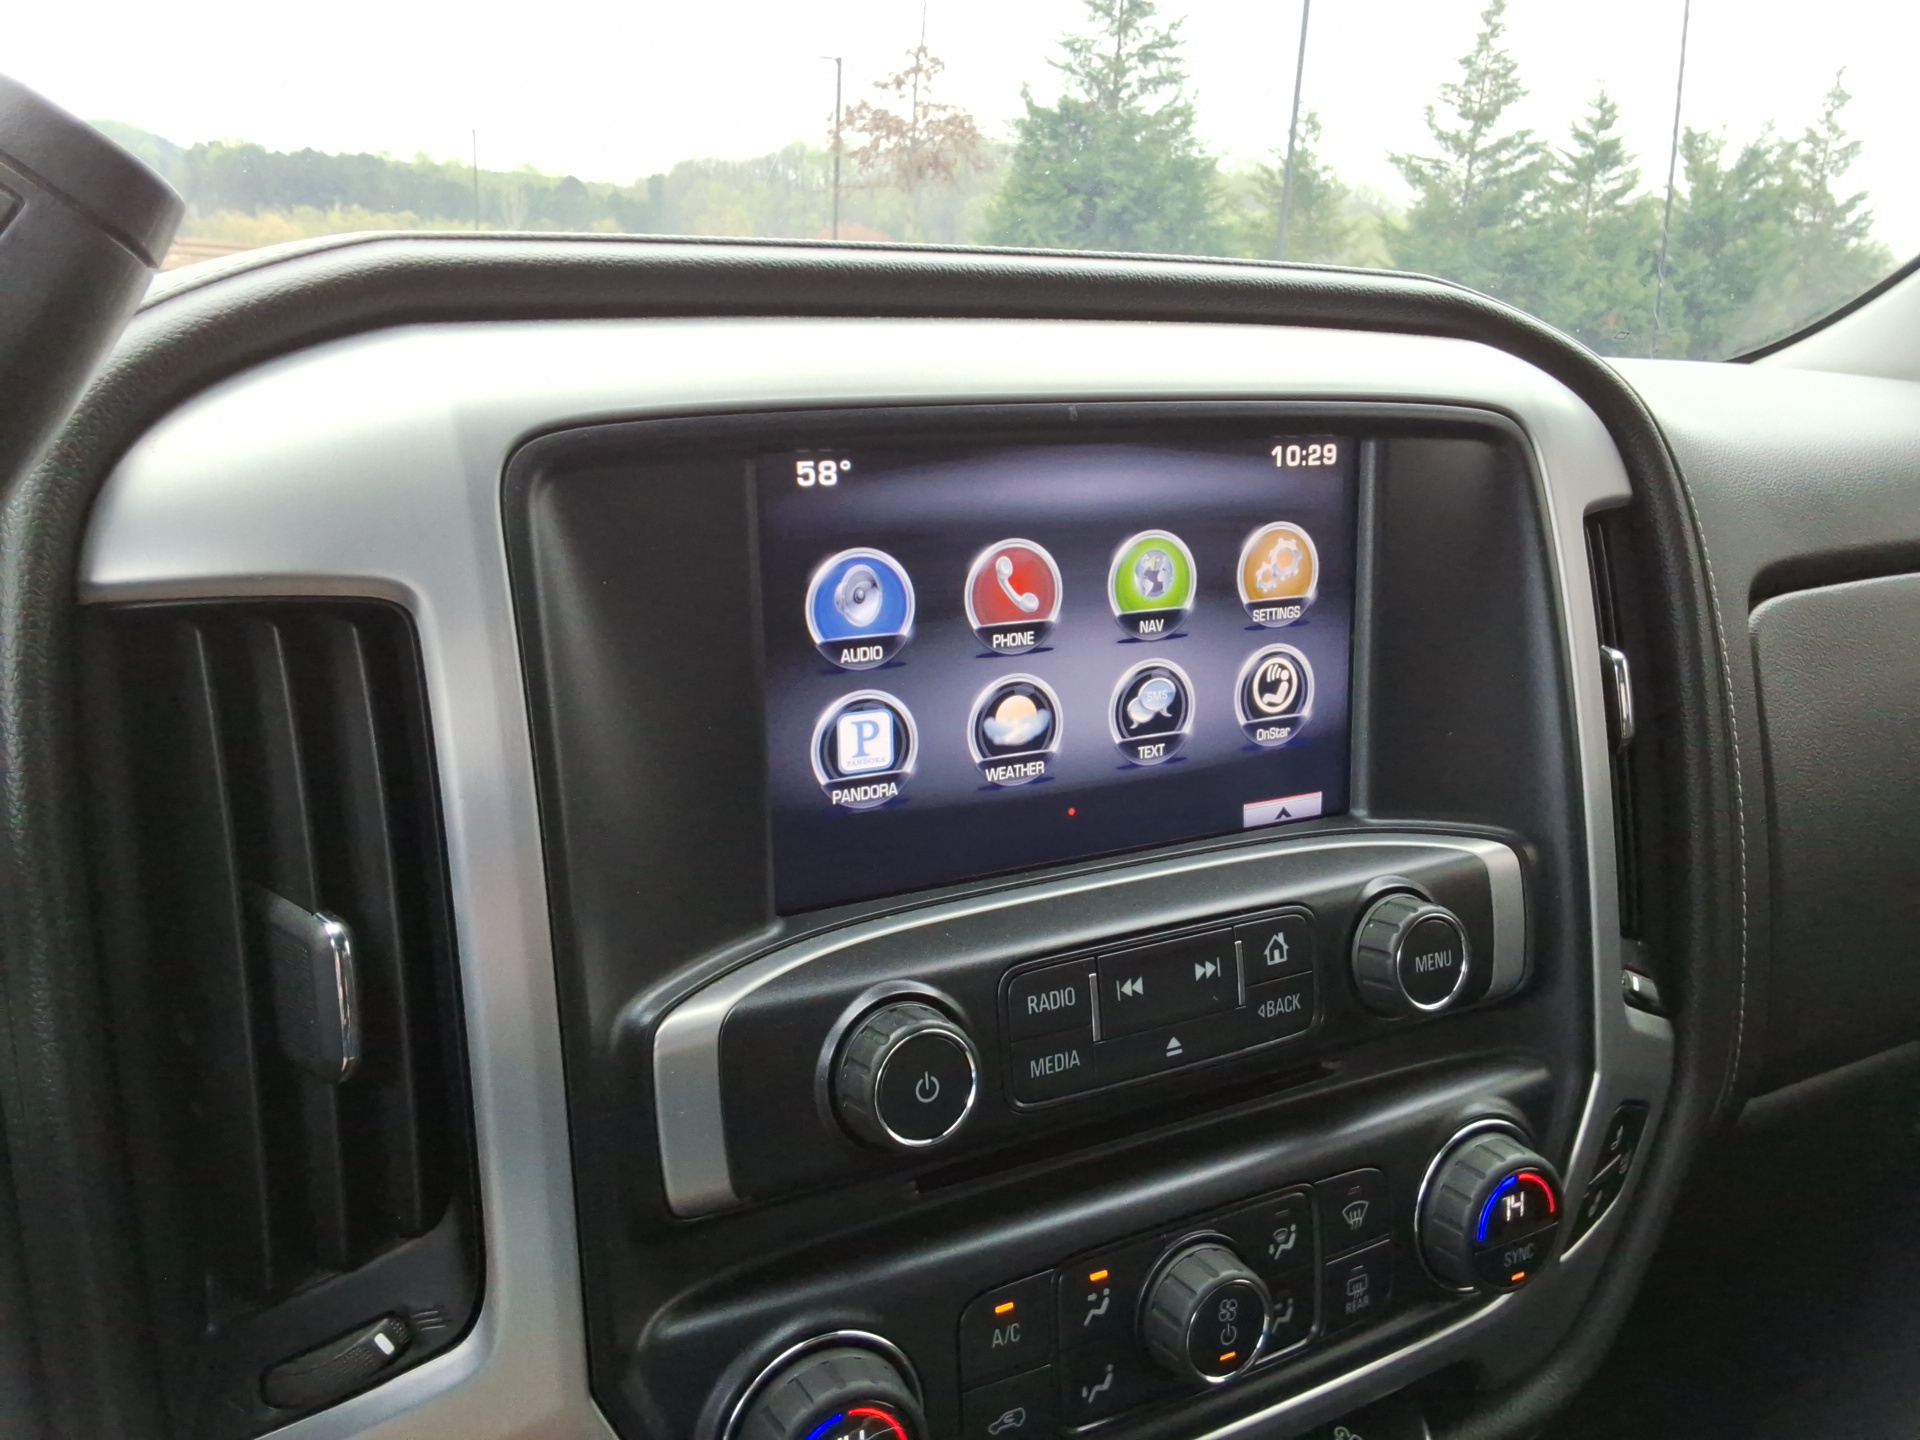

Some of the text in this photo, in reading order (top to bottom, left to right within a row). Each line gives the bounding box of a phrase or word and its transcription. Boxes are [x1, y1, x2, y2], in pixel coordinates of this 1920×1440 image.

[1271, 443, 1337, 467] 10:29
[1252, 605, 1301, 622] SETTINGS
[1139, 619, 1164, 634] NAV
[992, 631, 1035, 648] PHONE
[840, 646, 883, 664] AUDIO
[1146, 689, 1168, 702] SMS
[850, 720, 880, 758] P
[1256, 726, 1291, 742] OnStar
[847, 756, 886, 767] PANDORA
[1137, 743, 1165, 760] TEXT
[985, 761, 1045, 782] WEATHER
[832, 782, 898, 805] PANDORA
[1415, 950, 1452, 974] MENU
[1027, 987, 1076, 1015] RADIO
[1267, 992, 1301, 1017] BACK
[1030, 1050, 1080, 1079] MEDIA
[1502, 1191, 1524, 1221] 74
[1504, 1243, 1534, 1267] SYNC
[1345, 1295, 1369, 1315] REAR
[992, 1323, 1021, 1348] A/C
